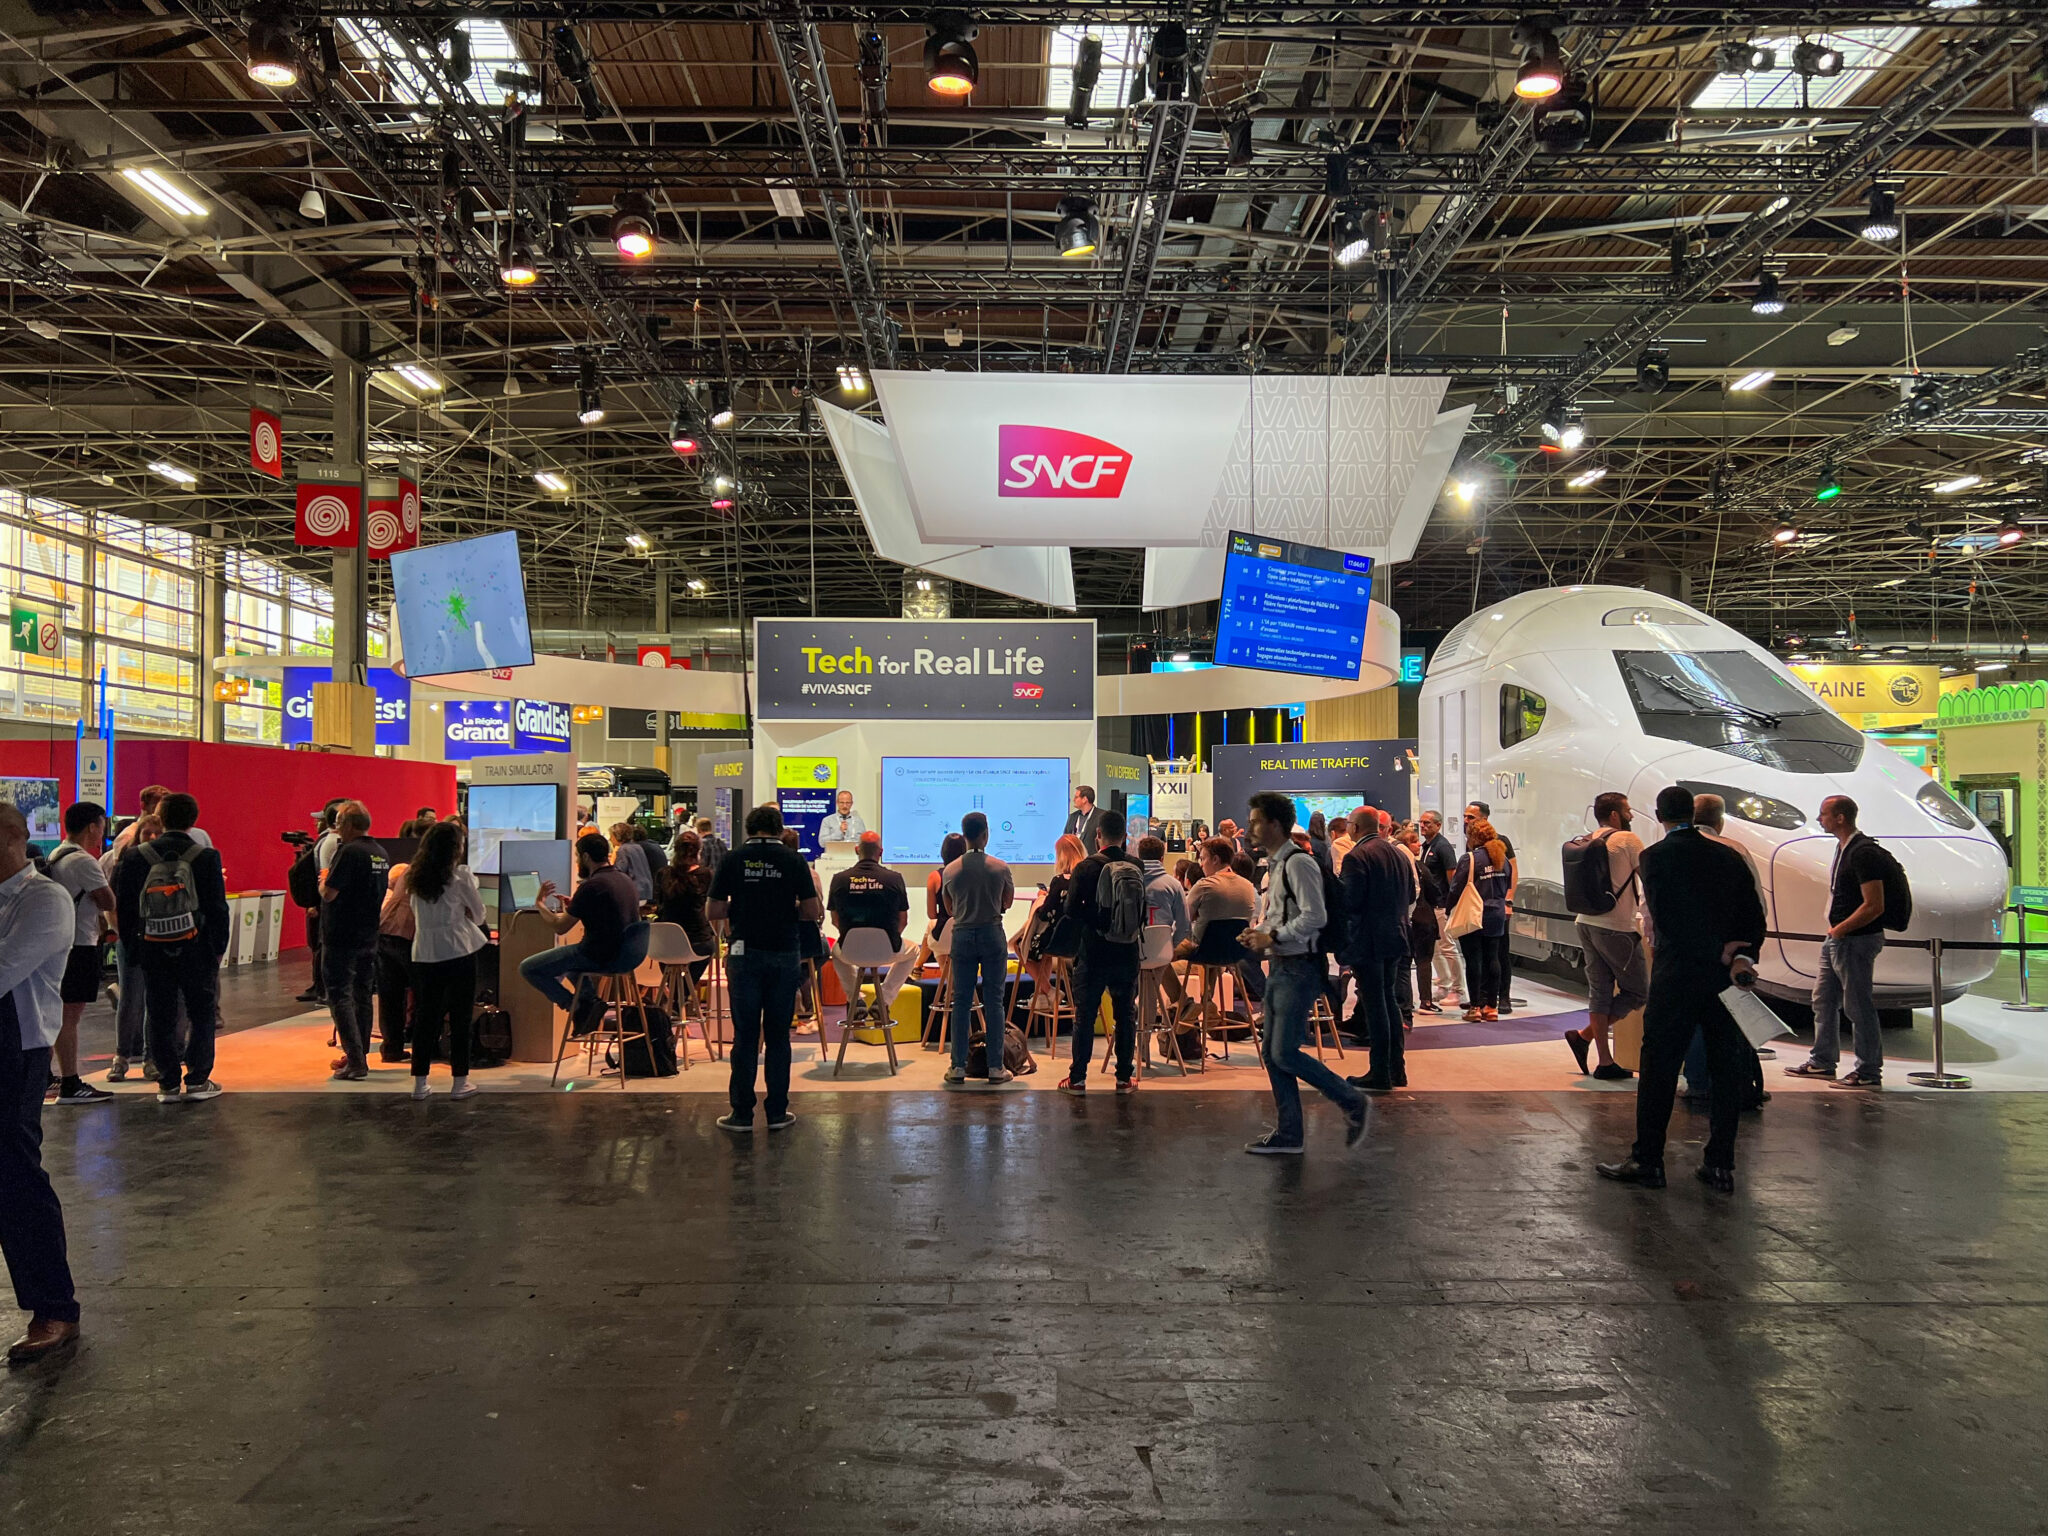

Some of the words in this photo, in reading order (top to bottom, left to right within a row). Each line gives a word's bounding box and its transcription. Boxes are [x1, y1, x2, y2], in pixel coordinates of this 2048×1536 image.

[318, 469, 340, 478] 1115
[1004, 454, 1123, 489] SNCF
[1224, 598, 1232, 620] 17H
[801, 646, 873, 674] Tech
[878, 655, 910, 675] for
[914, 647, 980, 675] Real
[987, 647, 1045, 675] Life
[801, 683, 872, 695] #VIVASNCF
[1013, 687, 1042, 697] SNCF
[1804, 682, 1865, 697] TAINE
[475, 718, 503, 726] Région
[516, 700, 552, 734] Grand
[552, 705, 570, 738] Est
[448, 723, 509, 740] Grand
[1260, 760, 1288, 770] REAL
[1290, 758, 1318, 770] TIME
[1320, 756, 1370, 769] TRAFFIC
[484, 766, 507, 776] TRAIN
[509, 764, 554, 776] SIMULATOR
[1157, 783, 1187, 794] XXII
[744, 860, 764, 868] Tech
[744, 869, 763, 877] Real
[766, 870, 782, 878] Life
[869, 882, 883, 890] Life
[148, 916, 190, 933] PUMA
